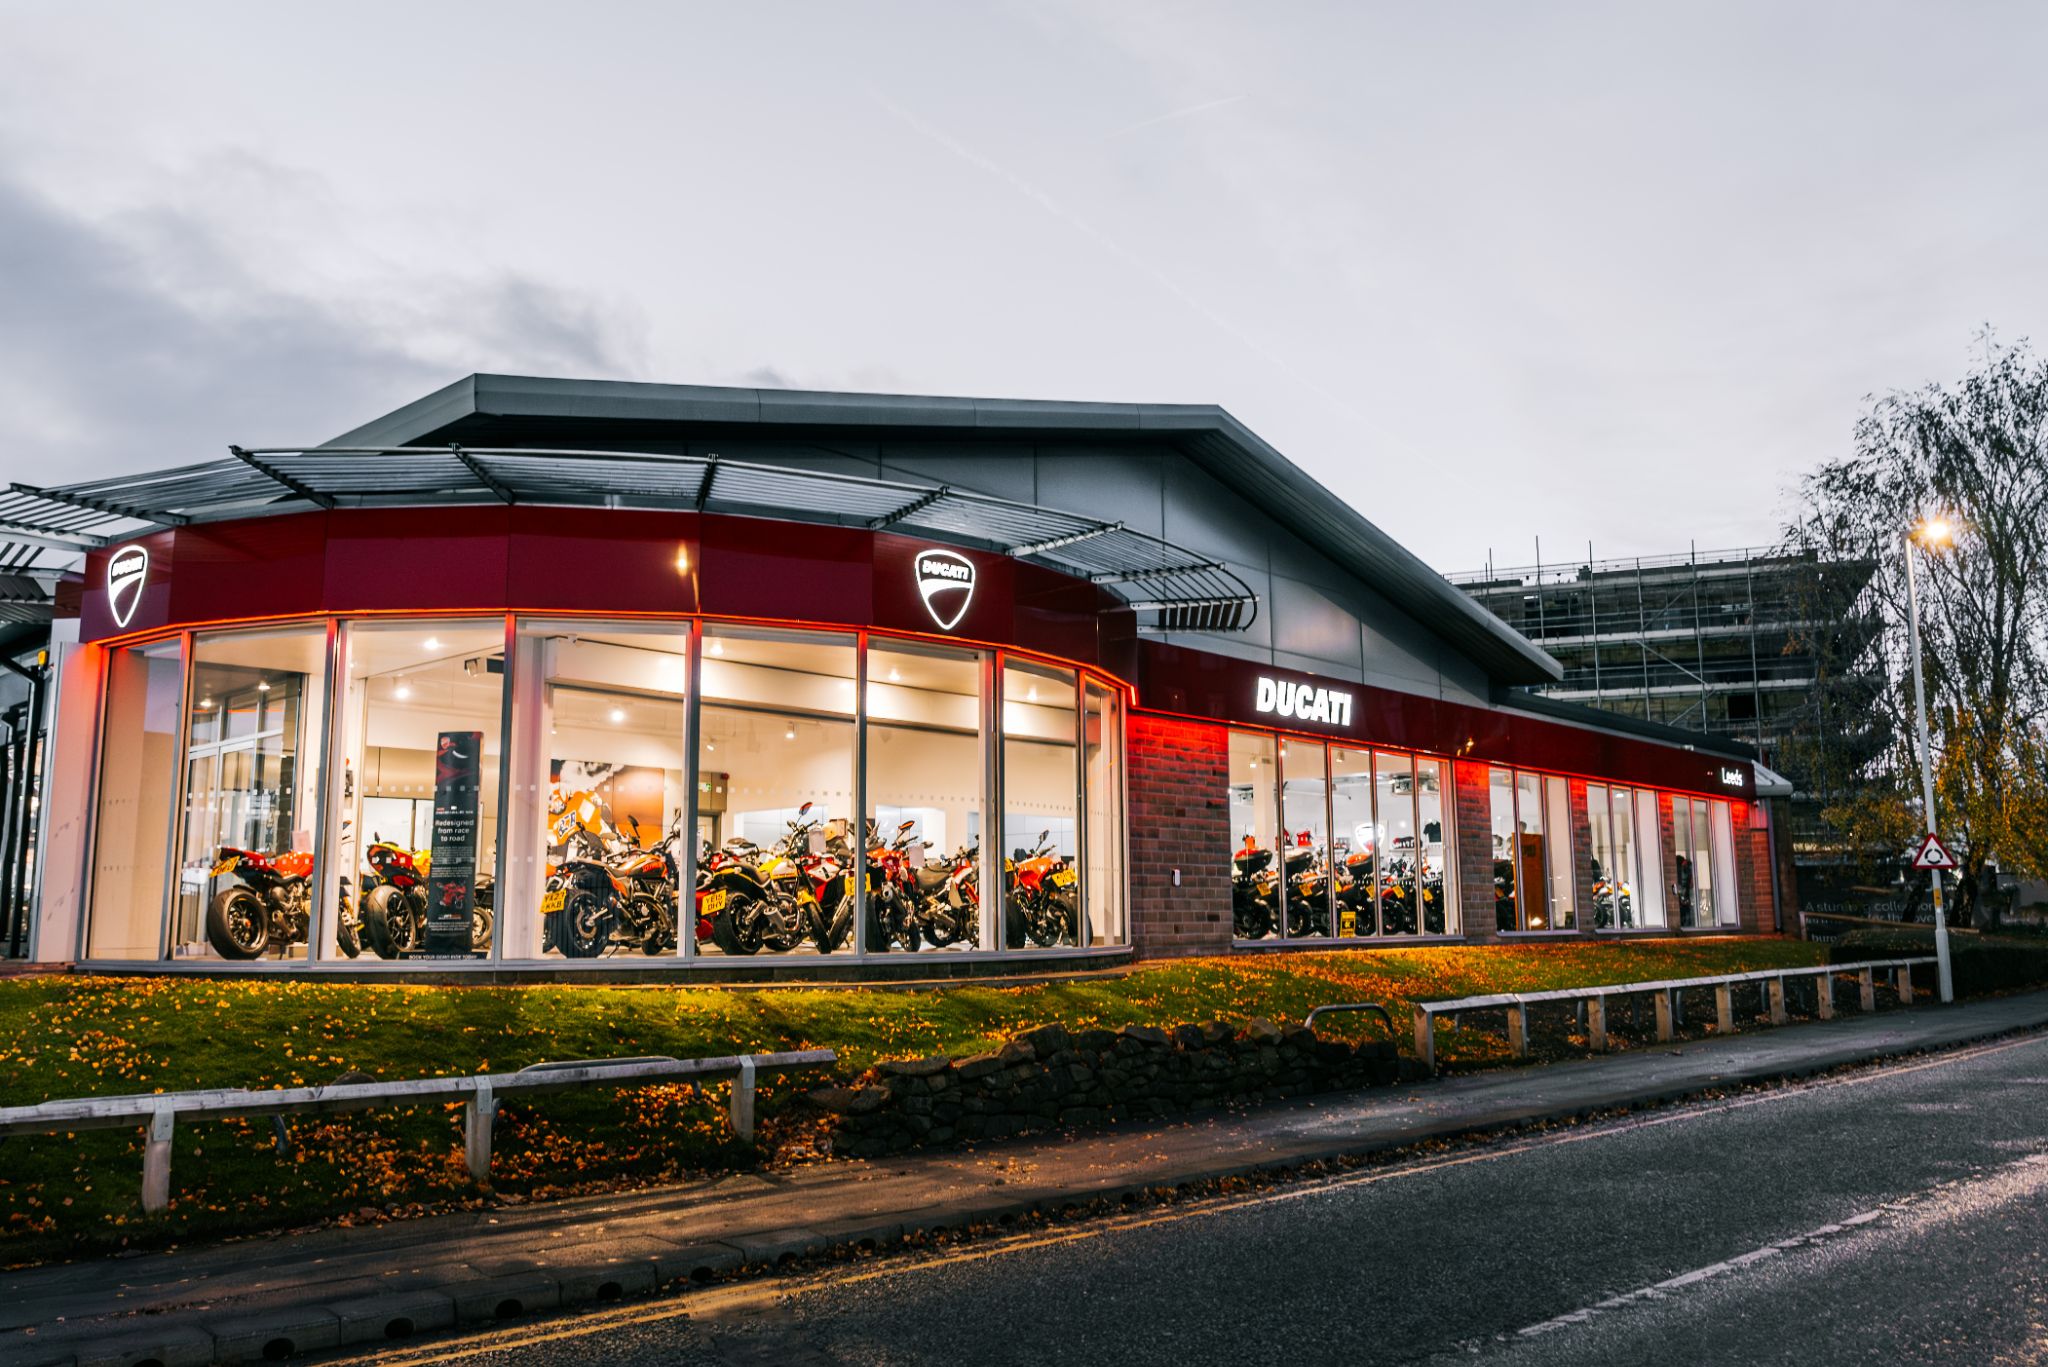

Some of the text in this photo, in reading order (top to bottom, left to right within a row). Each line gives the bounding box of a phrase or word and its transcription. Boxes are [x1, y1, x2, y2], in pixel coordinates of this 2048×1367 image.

[922, 560, 969, 580] DUCATI
[1256, 676, 1352, 727] DUCATI
[1721, 767, 1742, 786] Leeds
[435, 819, 474, 827] Redesigned
